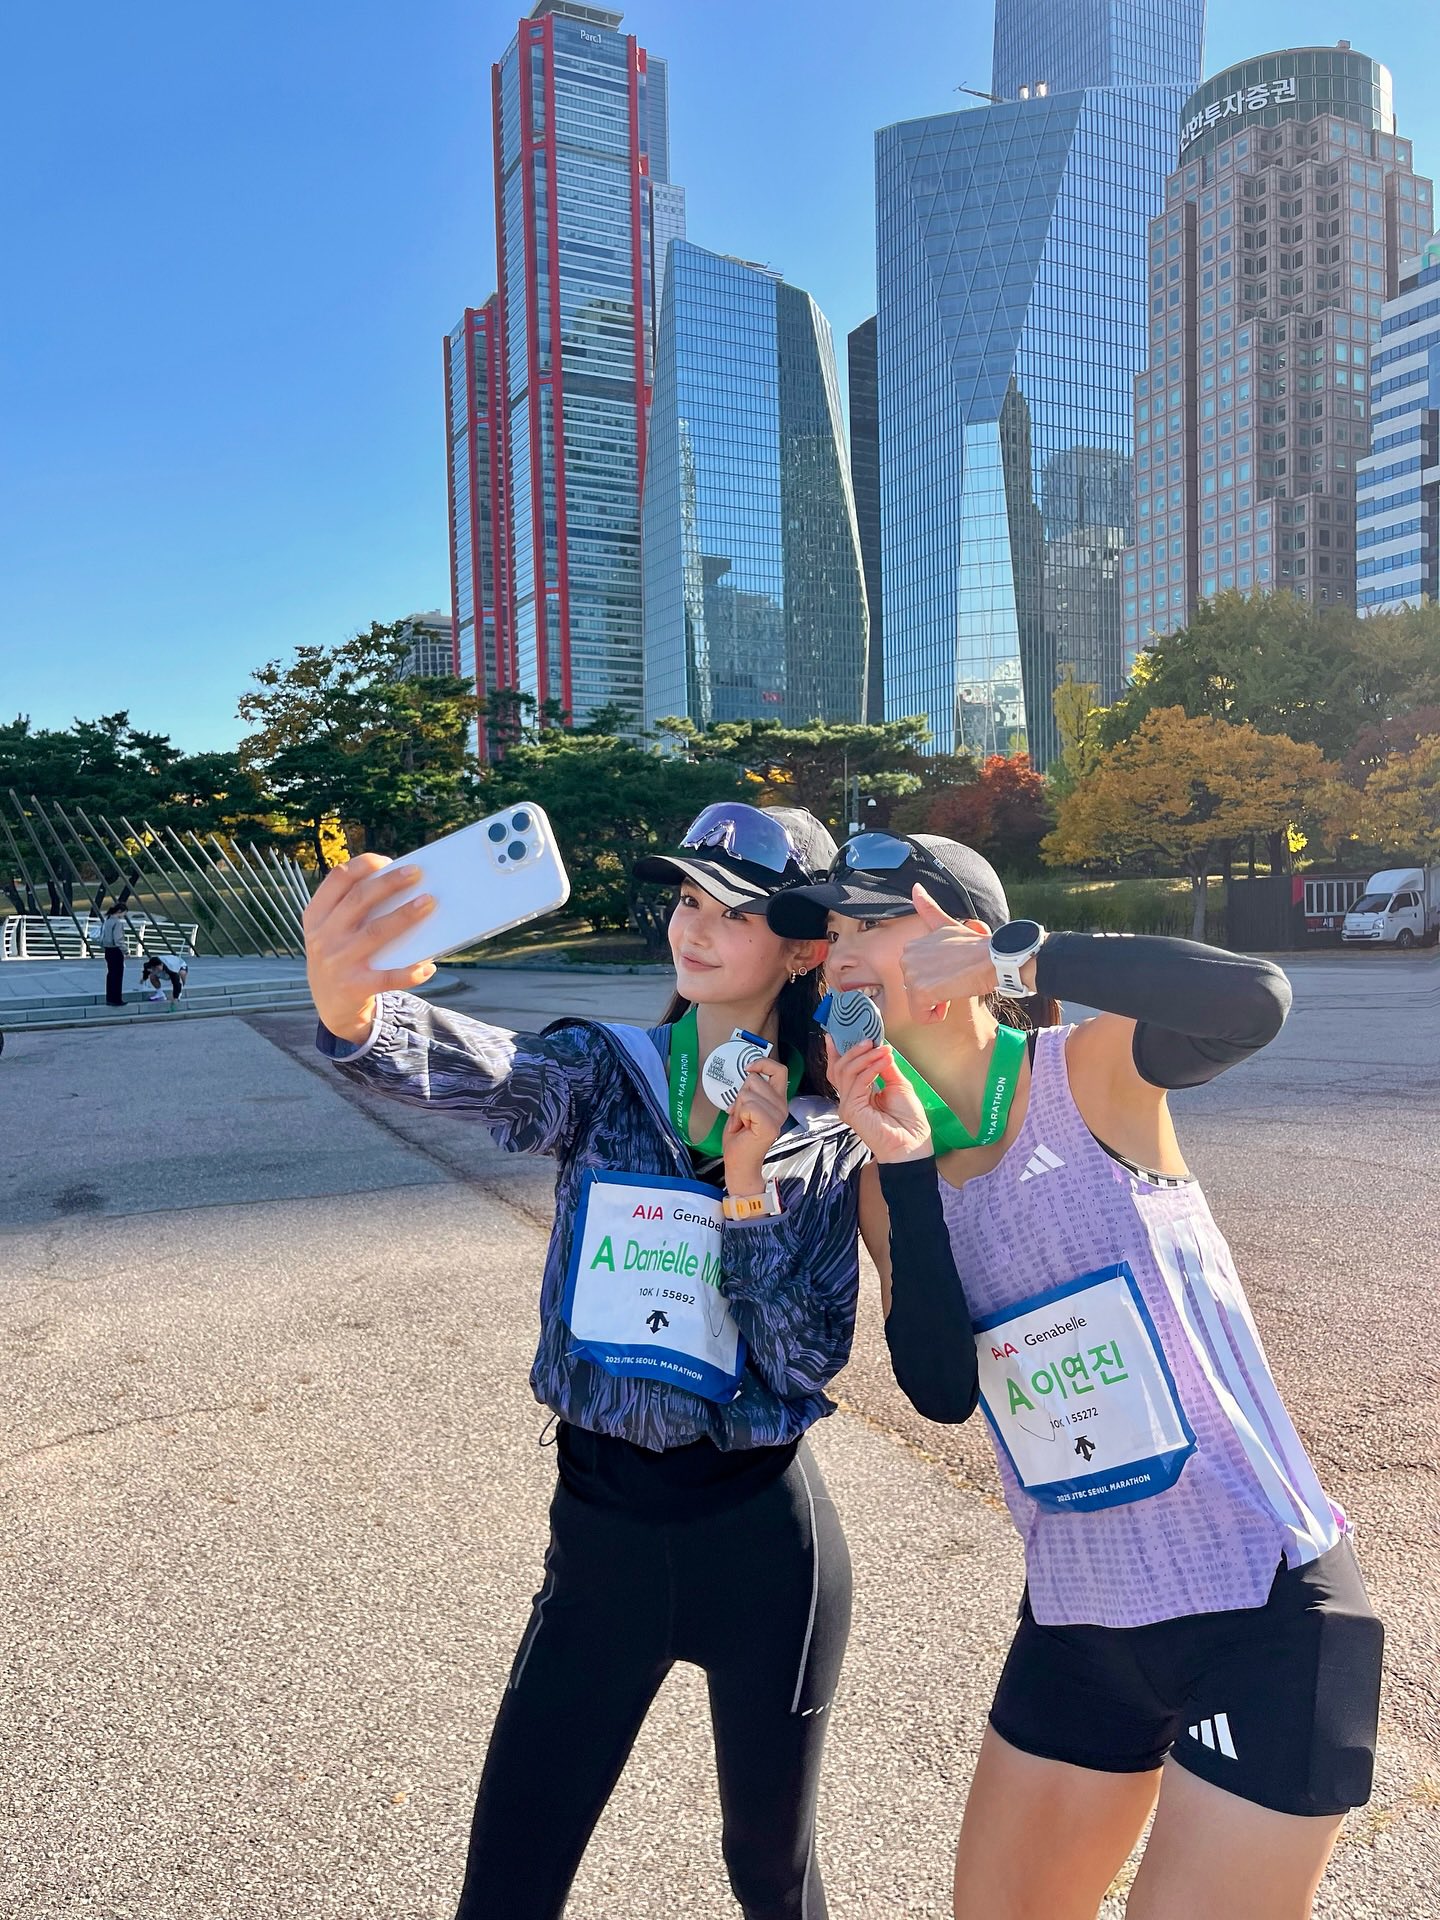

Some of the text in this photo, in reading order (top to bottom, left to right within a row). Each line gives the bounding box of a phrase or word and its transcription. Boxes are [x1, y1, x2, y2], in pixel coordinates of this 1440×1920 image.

[1180, 77, 1297, 153] 신한투자증권
[676, 1053, 689, 1128] SEOUL MARATHON
[987, 1076, 1007, 1135] MARATHON
[631, 1204, 726, 1233] AIA Genabell
[589, 1235, 616, 1272] A
[623, 1239, 699, 1277] Danielle
[639, 1287, 654, 1297] 10K
[662, 1289, 696, 1305] 55892
[1024, 1316, 1087, 1346] Genabelle
[635, 1357, 658, 1366] SEOUL
[660, 1360, 703, 1381] MARATHON
[1006, 1340, 1129, 1415] A 이연진
[1071, 1407, 1099, 1423] 55272
[1110, 1473, 1151, 1491] MARATHON
